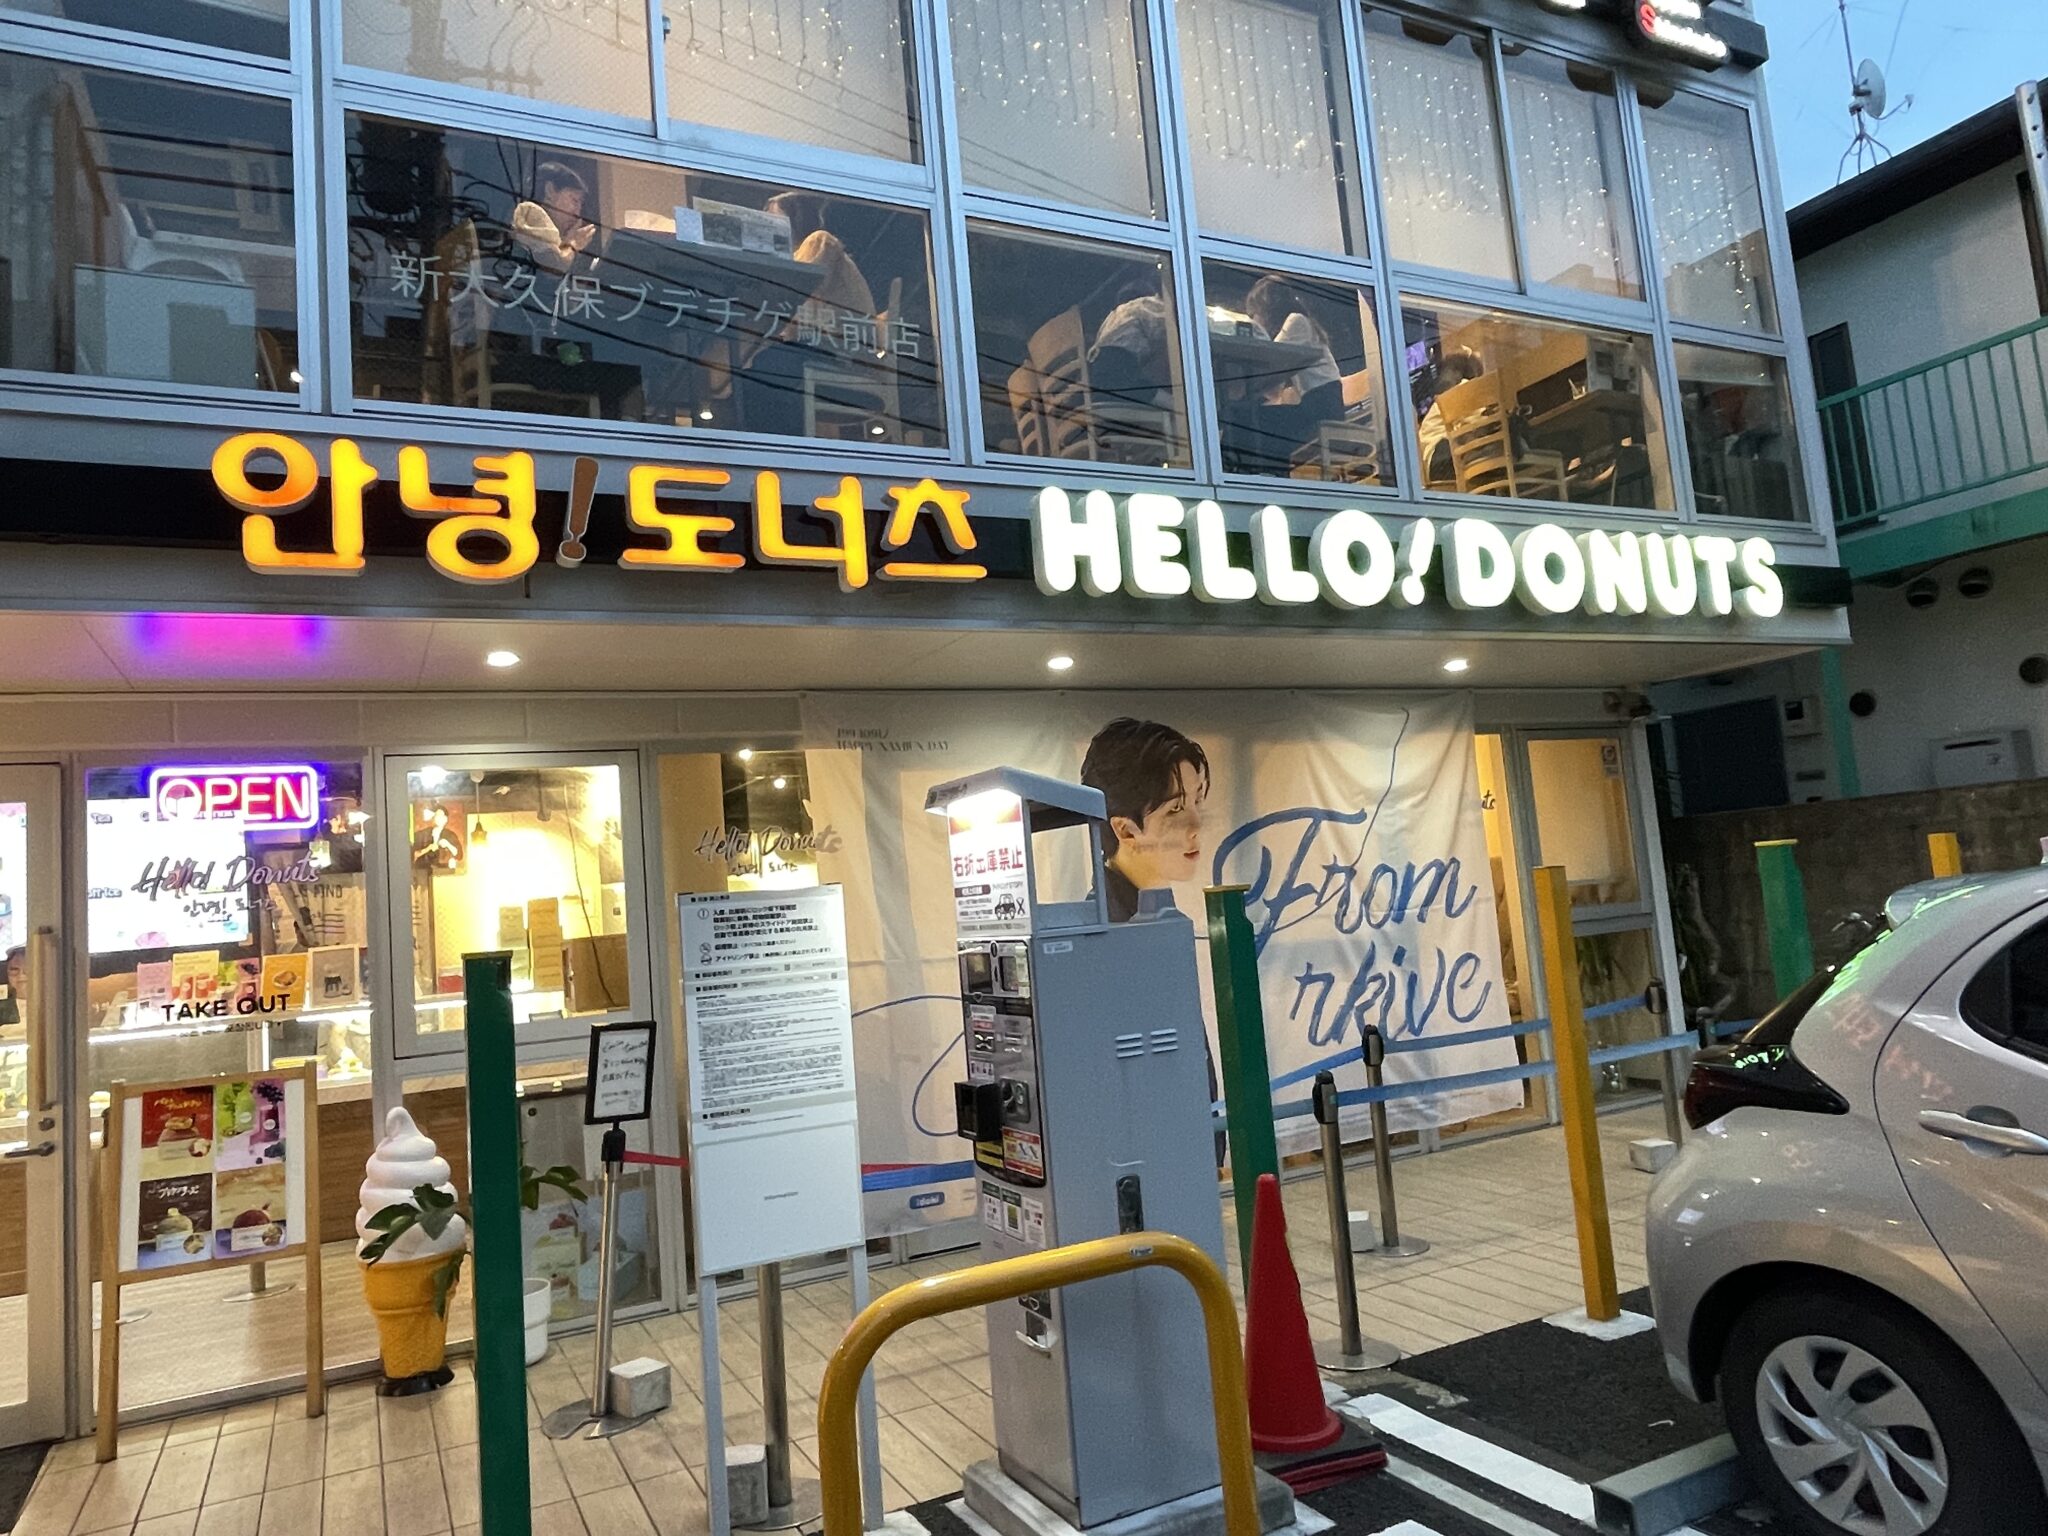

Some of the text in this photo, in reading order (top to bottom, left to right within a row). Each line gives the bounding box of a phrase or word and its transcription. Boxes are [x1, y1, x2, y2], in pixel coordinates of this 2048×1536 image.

[210, 432, 600, 580] 안녕!
[1032, 486, 1785, 618] HELLO! DONUTS
[159, 776, 310, 820] OPEN
[760, 824, 843, 857] Donuts
[226, 849, 321, 893] Donuts
[1212, 806, 1478, 960] From
[161, 993, 291, 1022] TAKE OUT
